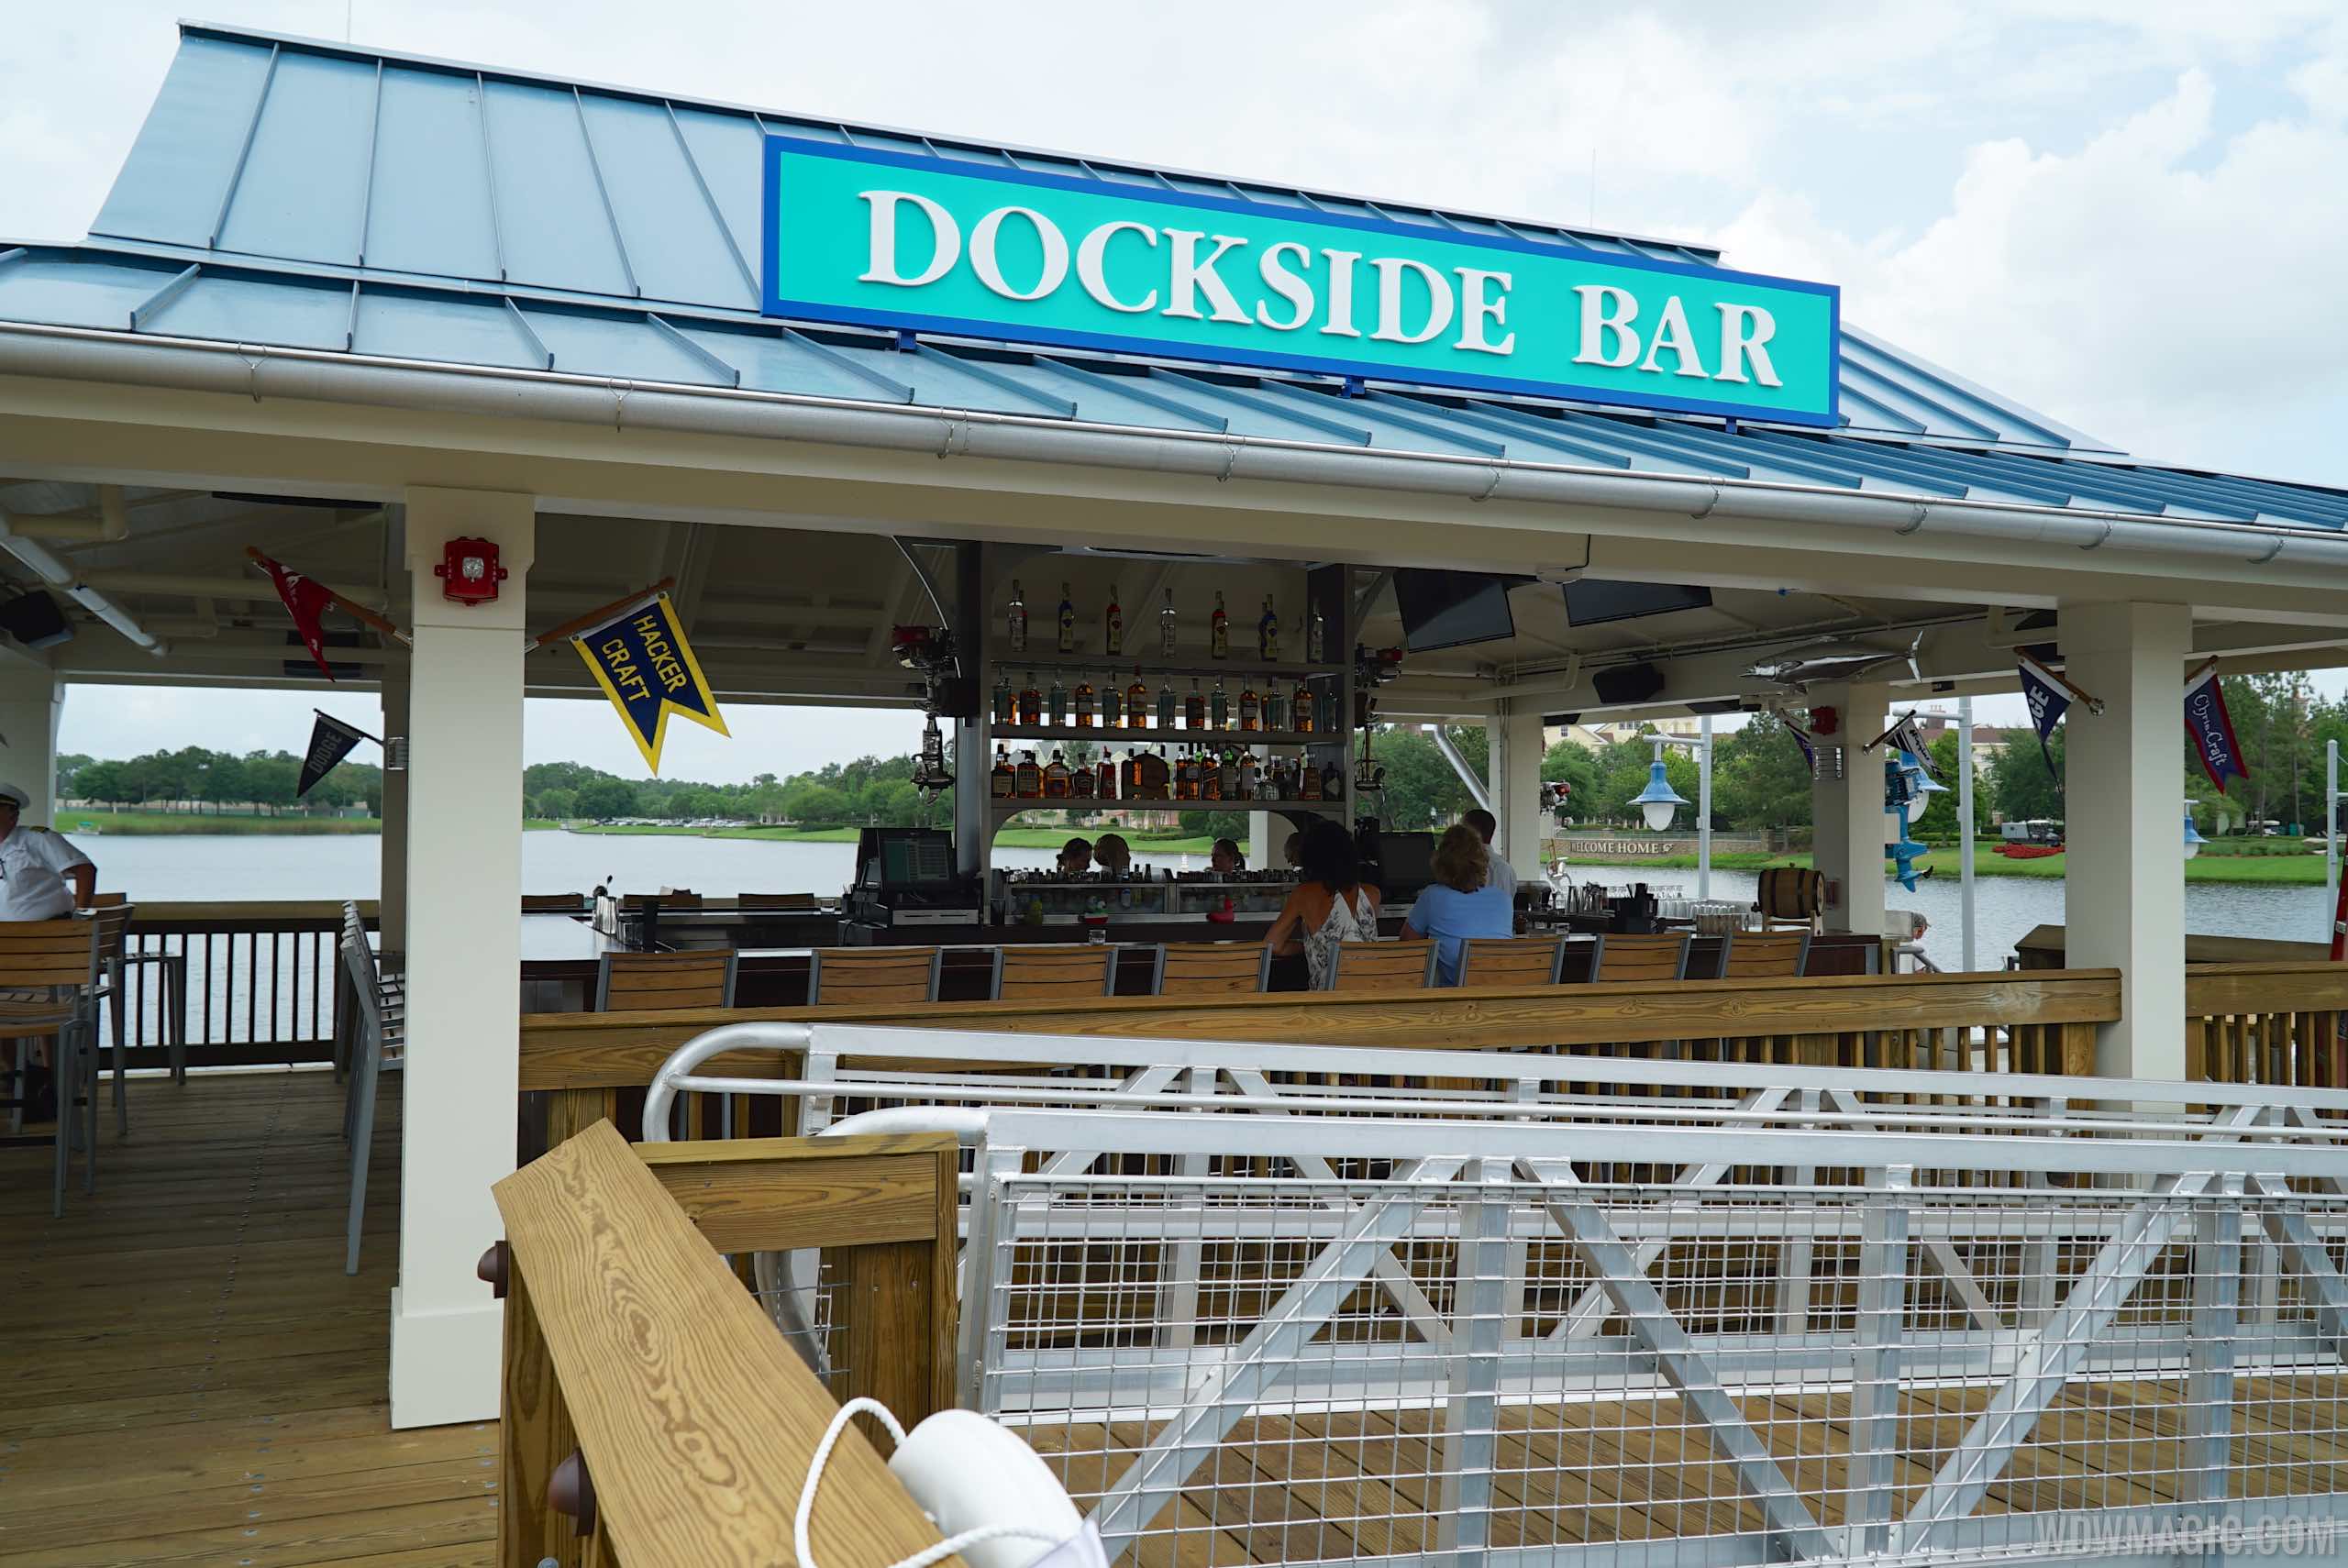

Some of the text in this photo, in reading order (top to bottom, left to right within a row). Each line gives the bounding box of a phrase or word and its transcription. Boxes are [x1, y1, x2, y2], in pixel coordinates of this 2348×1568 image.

[857, 189, 1783, 388] DOCKSIDE BAR
[602, 638, 650, 701] CRAFT
[632, 614, 687, 693] HACKER
[307, 731, 343, 774] DODGE
[1618, 843, 1659, 854] HOME
